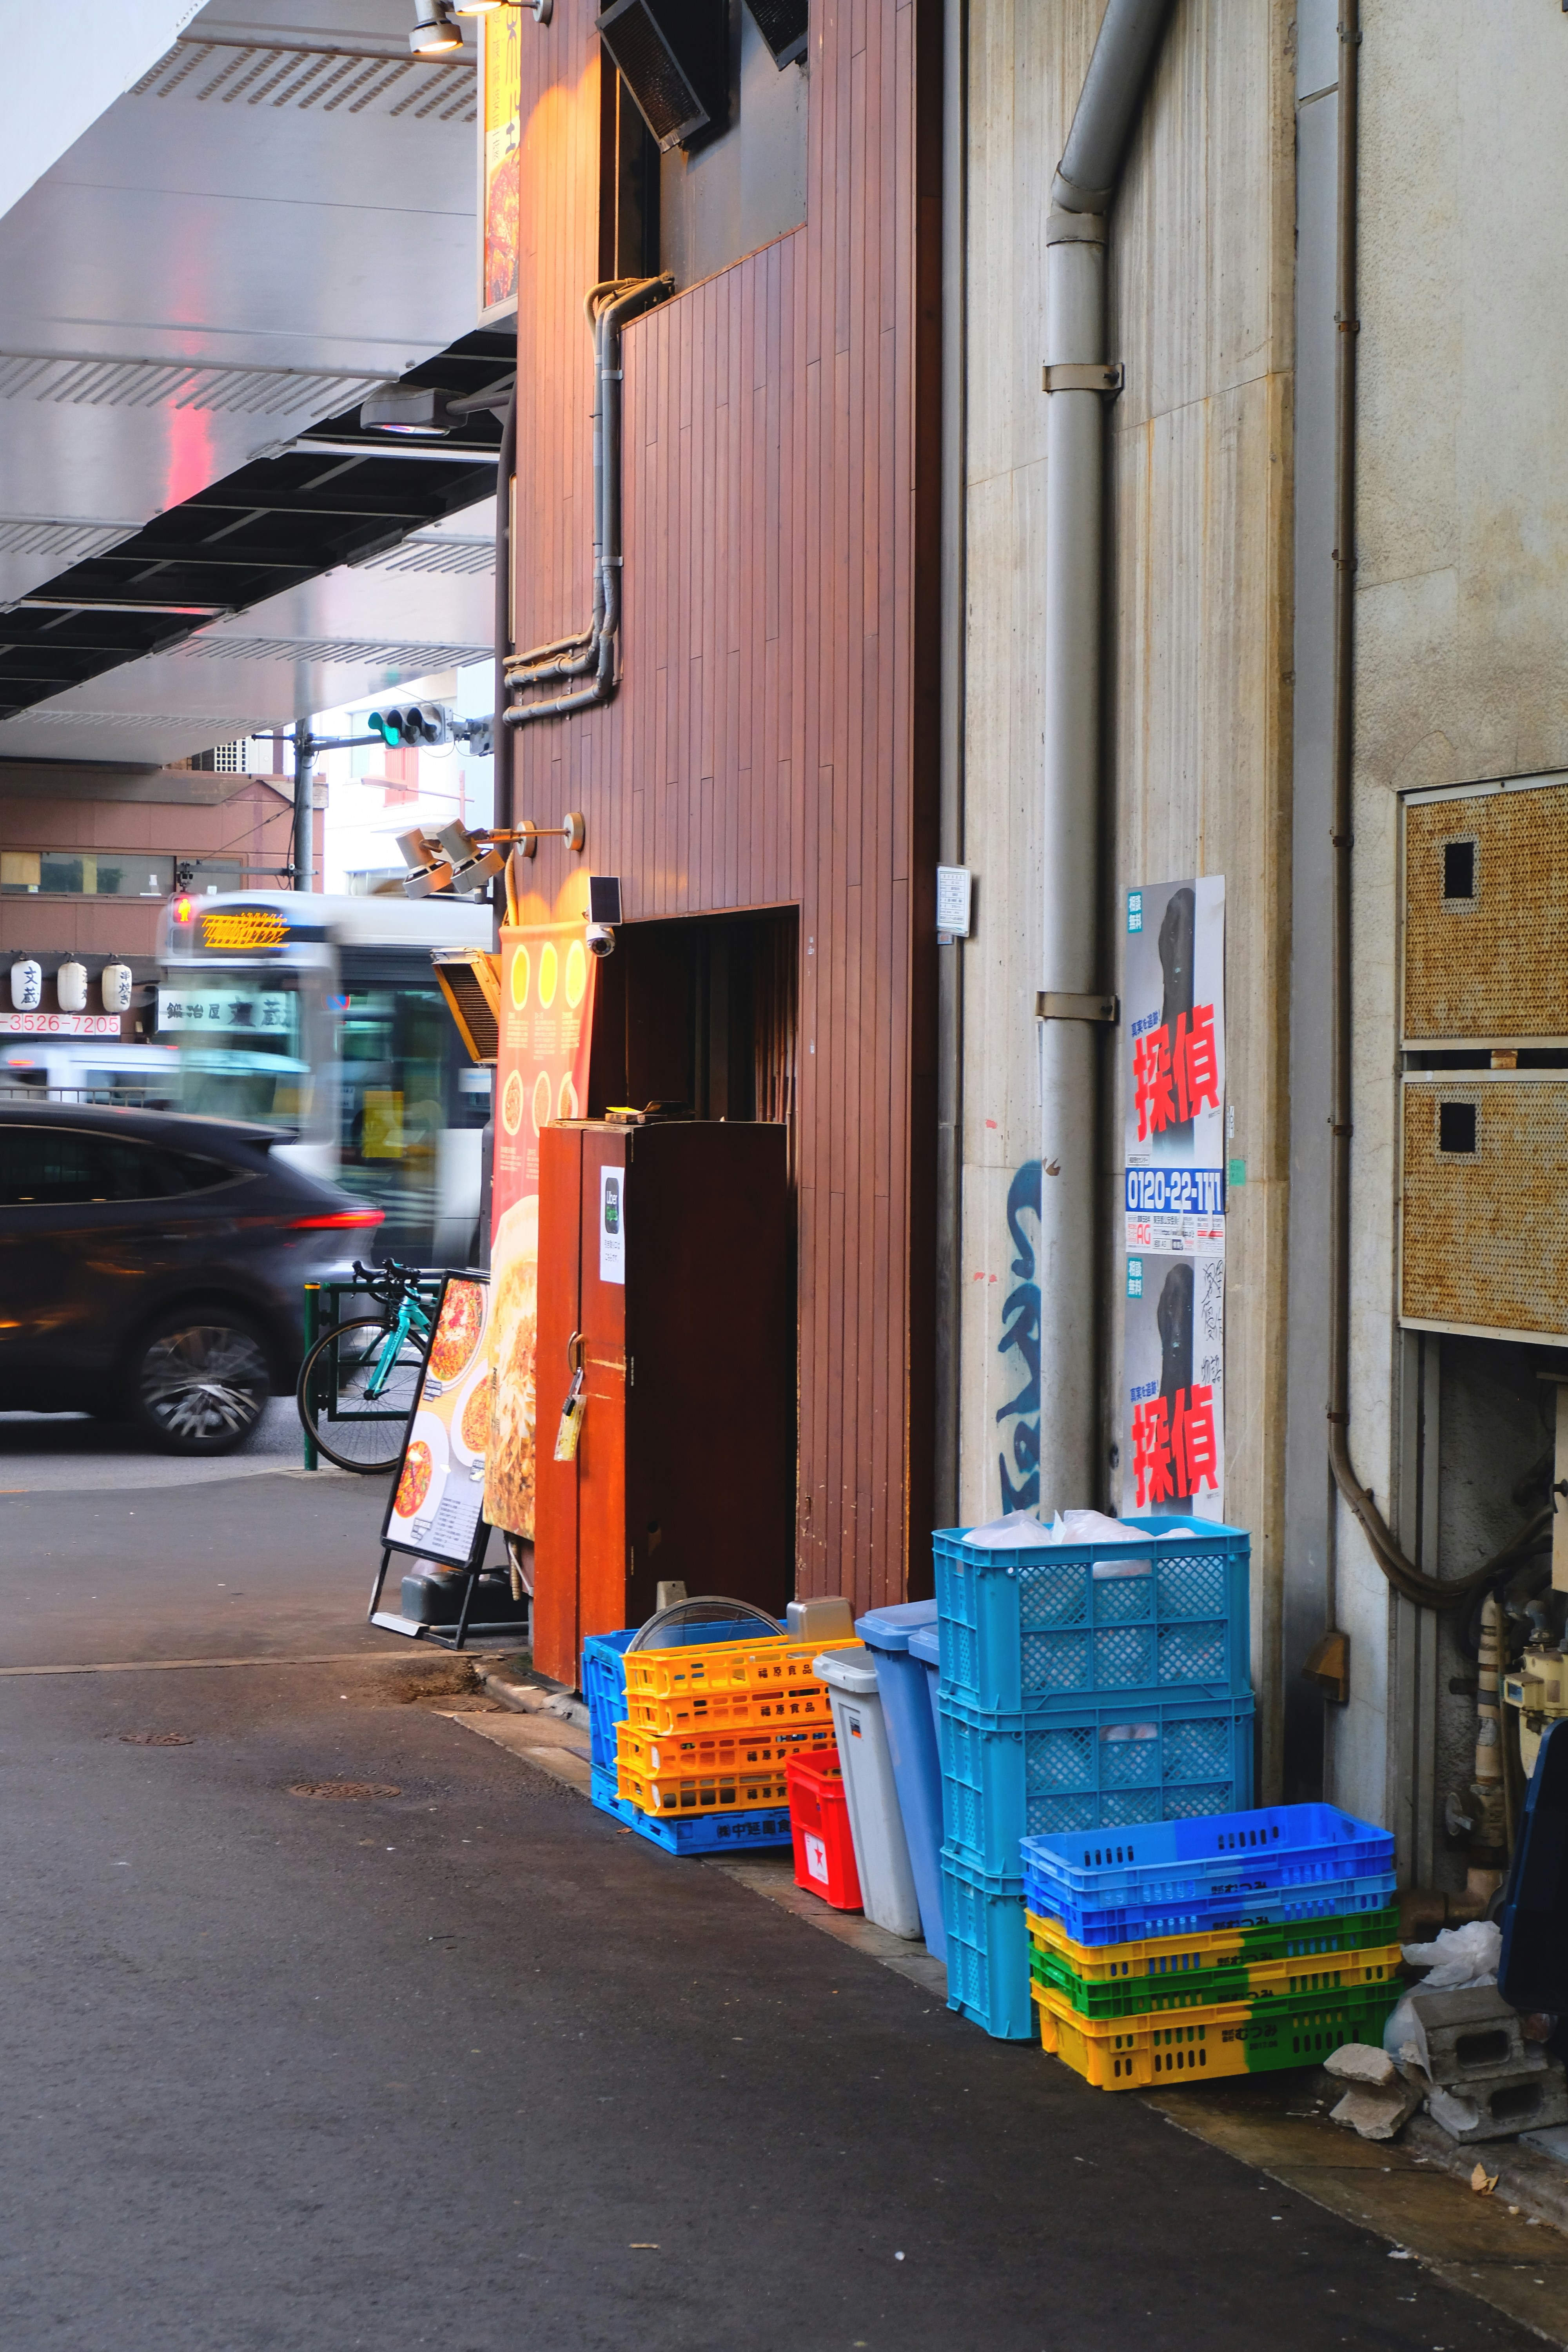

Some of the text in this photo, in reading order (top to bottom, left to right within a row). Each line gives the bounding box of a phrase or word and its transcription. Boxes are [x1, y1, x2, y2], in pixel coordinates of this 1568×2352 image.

[21, 966, 39, 1004] 文蔵
[118, 970, 131, 1005] 串焼き
[1132, 1003, 1221, 1142] 探偵
[1128, 1170, 1221, 1212] 0120-22-1111
[1137, 1224, 1151, 1245] AG
[1128, 1261, 1142, 1277] 相談
[1128, 1278, 1142, 1296] 無料
[1132, 1383, 1219, 1509] 探偵
[758, 1664, 812, 1679] 福原食品
[760, 1702, 815, 1717] 福原食品
